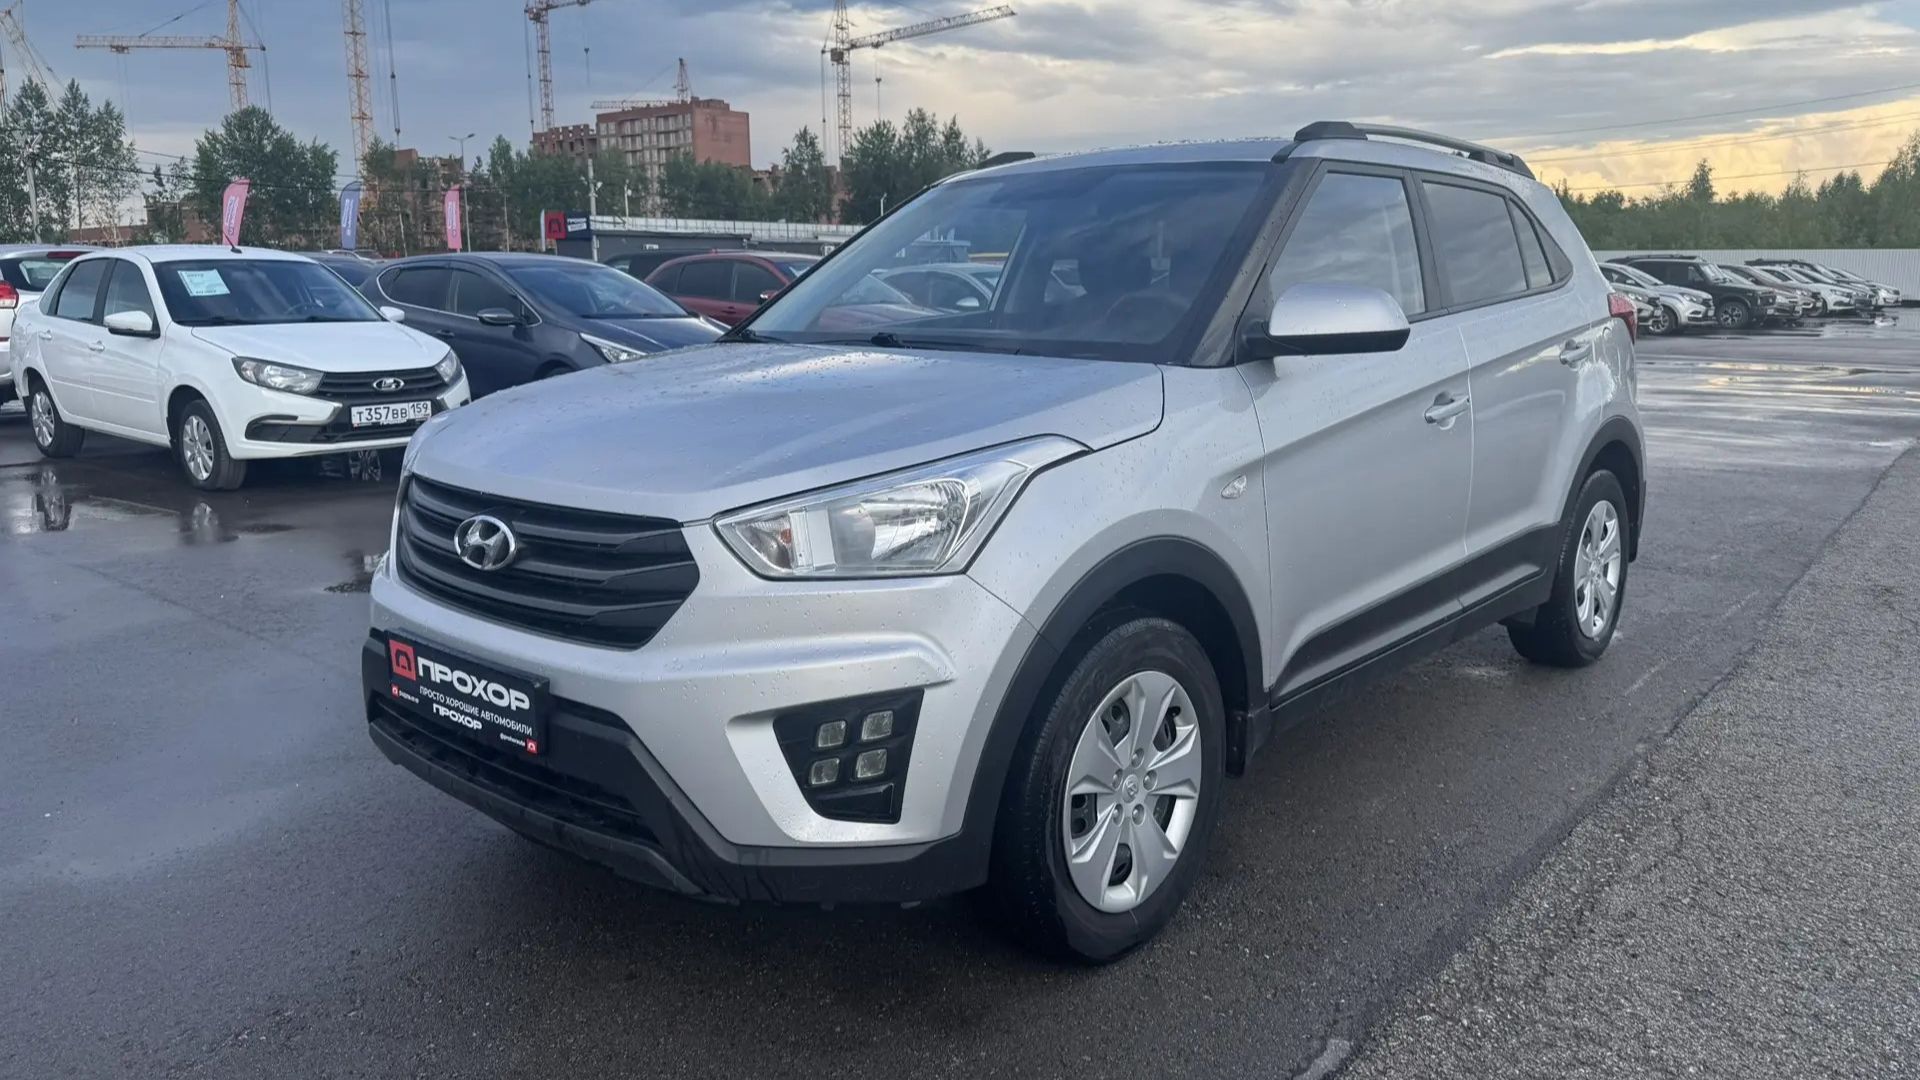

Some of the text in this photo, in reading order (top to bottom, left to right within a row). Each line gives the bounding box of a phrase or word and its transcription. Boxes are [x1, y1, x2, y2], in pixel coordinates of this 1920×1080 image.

[411, 402, 429, 414] 159
[417, 656, 530, 711] ПРОХОР
[420, 685, 445, 703] ПРОСТО
[446, 695, 480, 717] ХОРОШИЕ
[481, 710, 533, 737] АВТОМОБИЛИ
[433, 703, 483, 730] ПРОХОР
